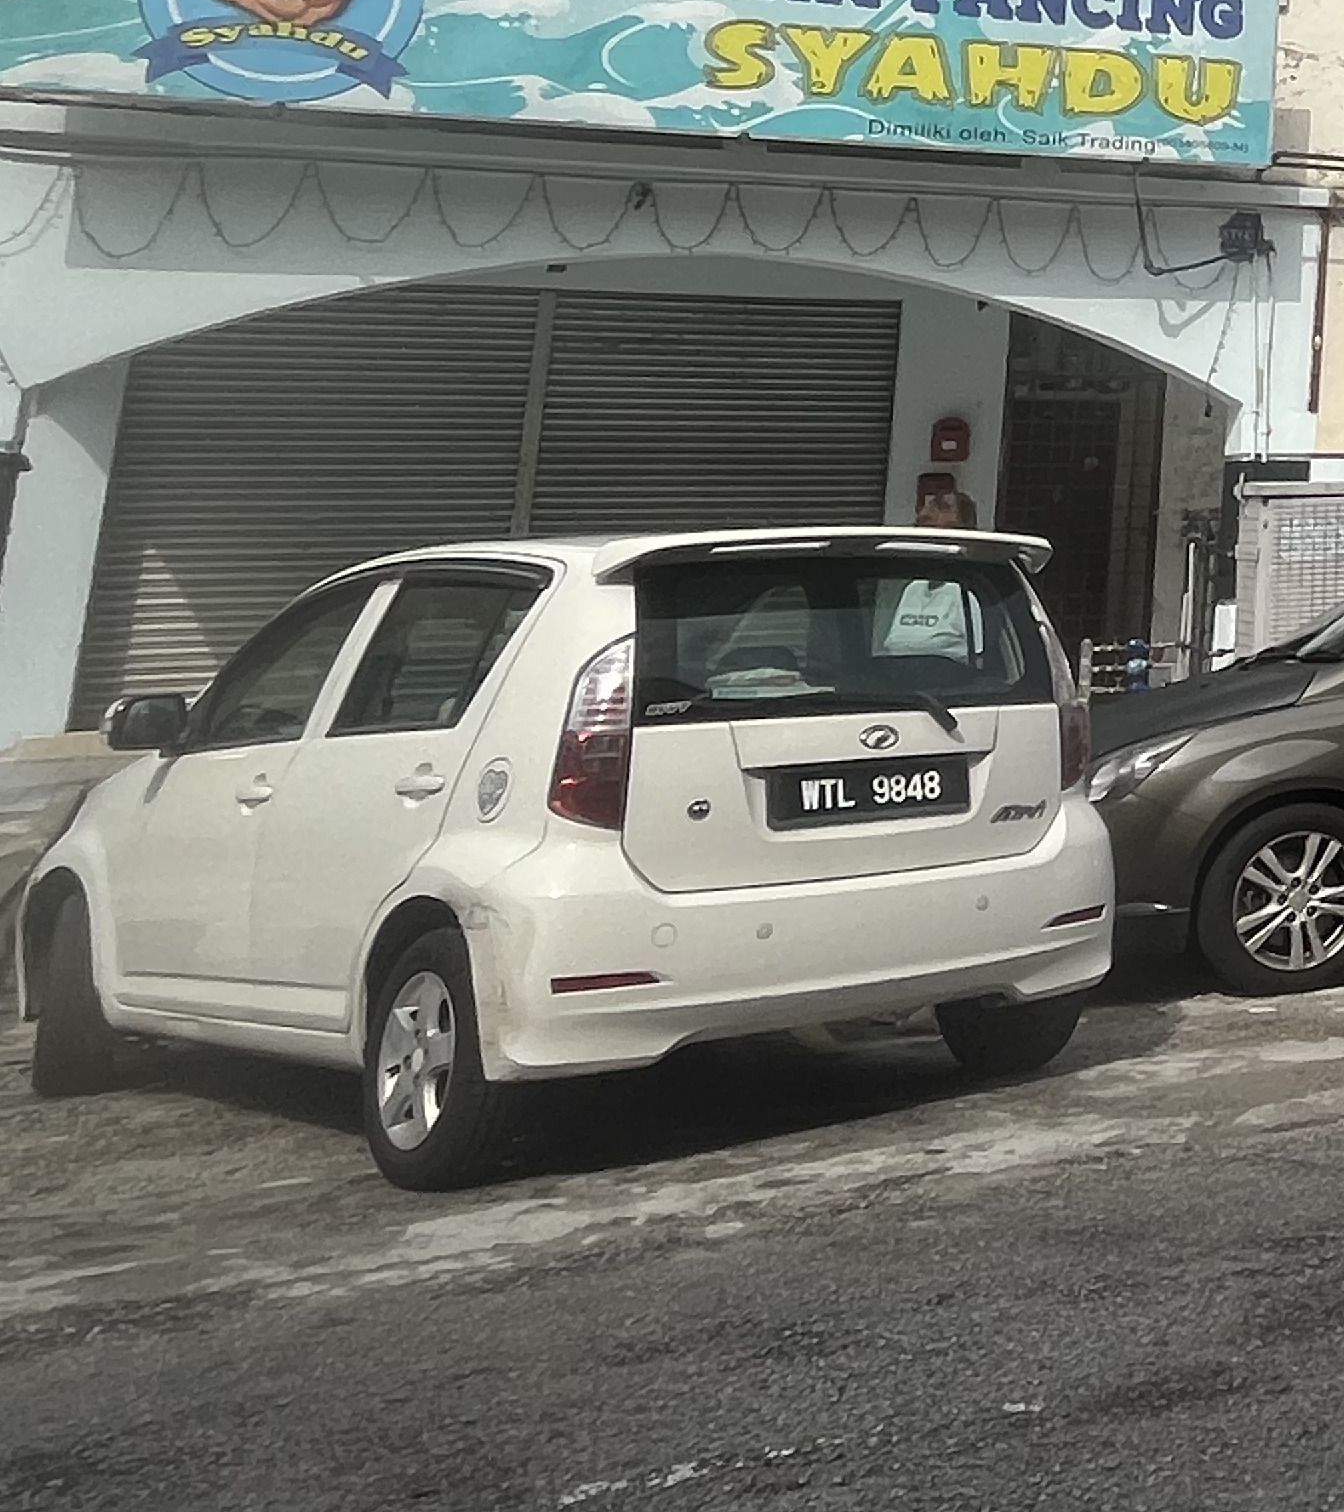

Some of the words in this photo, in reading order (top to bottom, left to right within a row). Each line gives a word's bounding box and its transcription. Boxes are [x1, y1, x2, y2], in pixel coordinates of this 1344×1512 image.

[180, 22, 369, 61] Syahdu
[705, 19, 1240, 126] SYAHDU
[868, 119, 951, 140] Dimiliki
[1022, 130, 1069, 147] Saik
[1077, 133, 1157, 156] Trading
[800, 778, 856, 810] WTL
[872, 770, 941, 804] 9848
